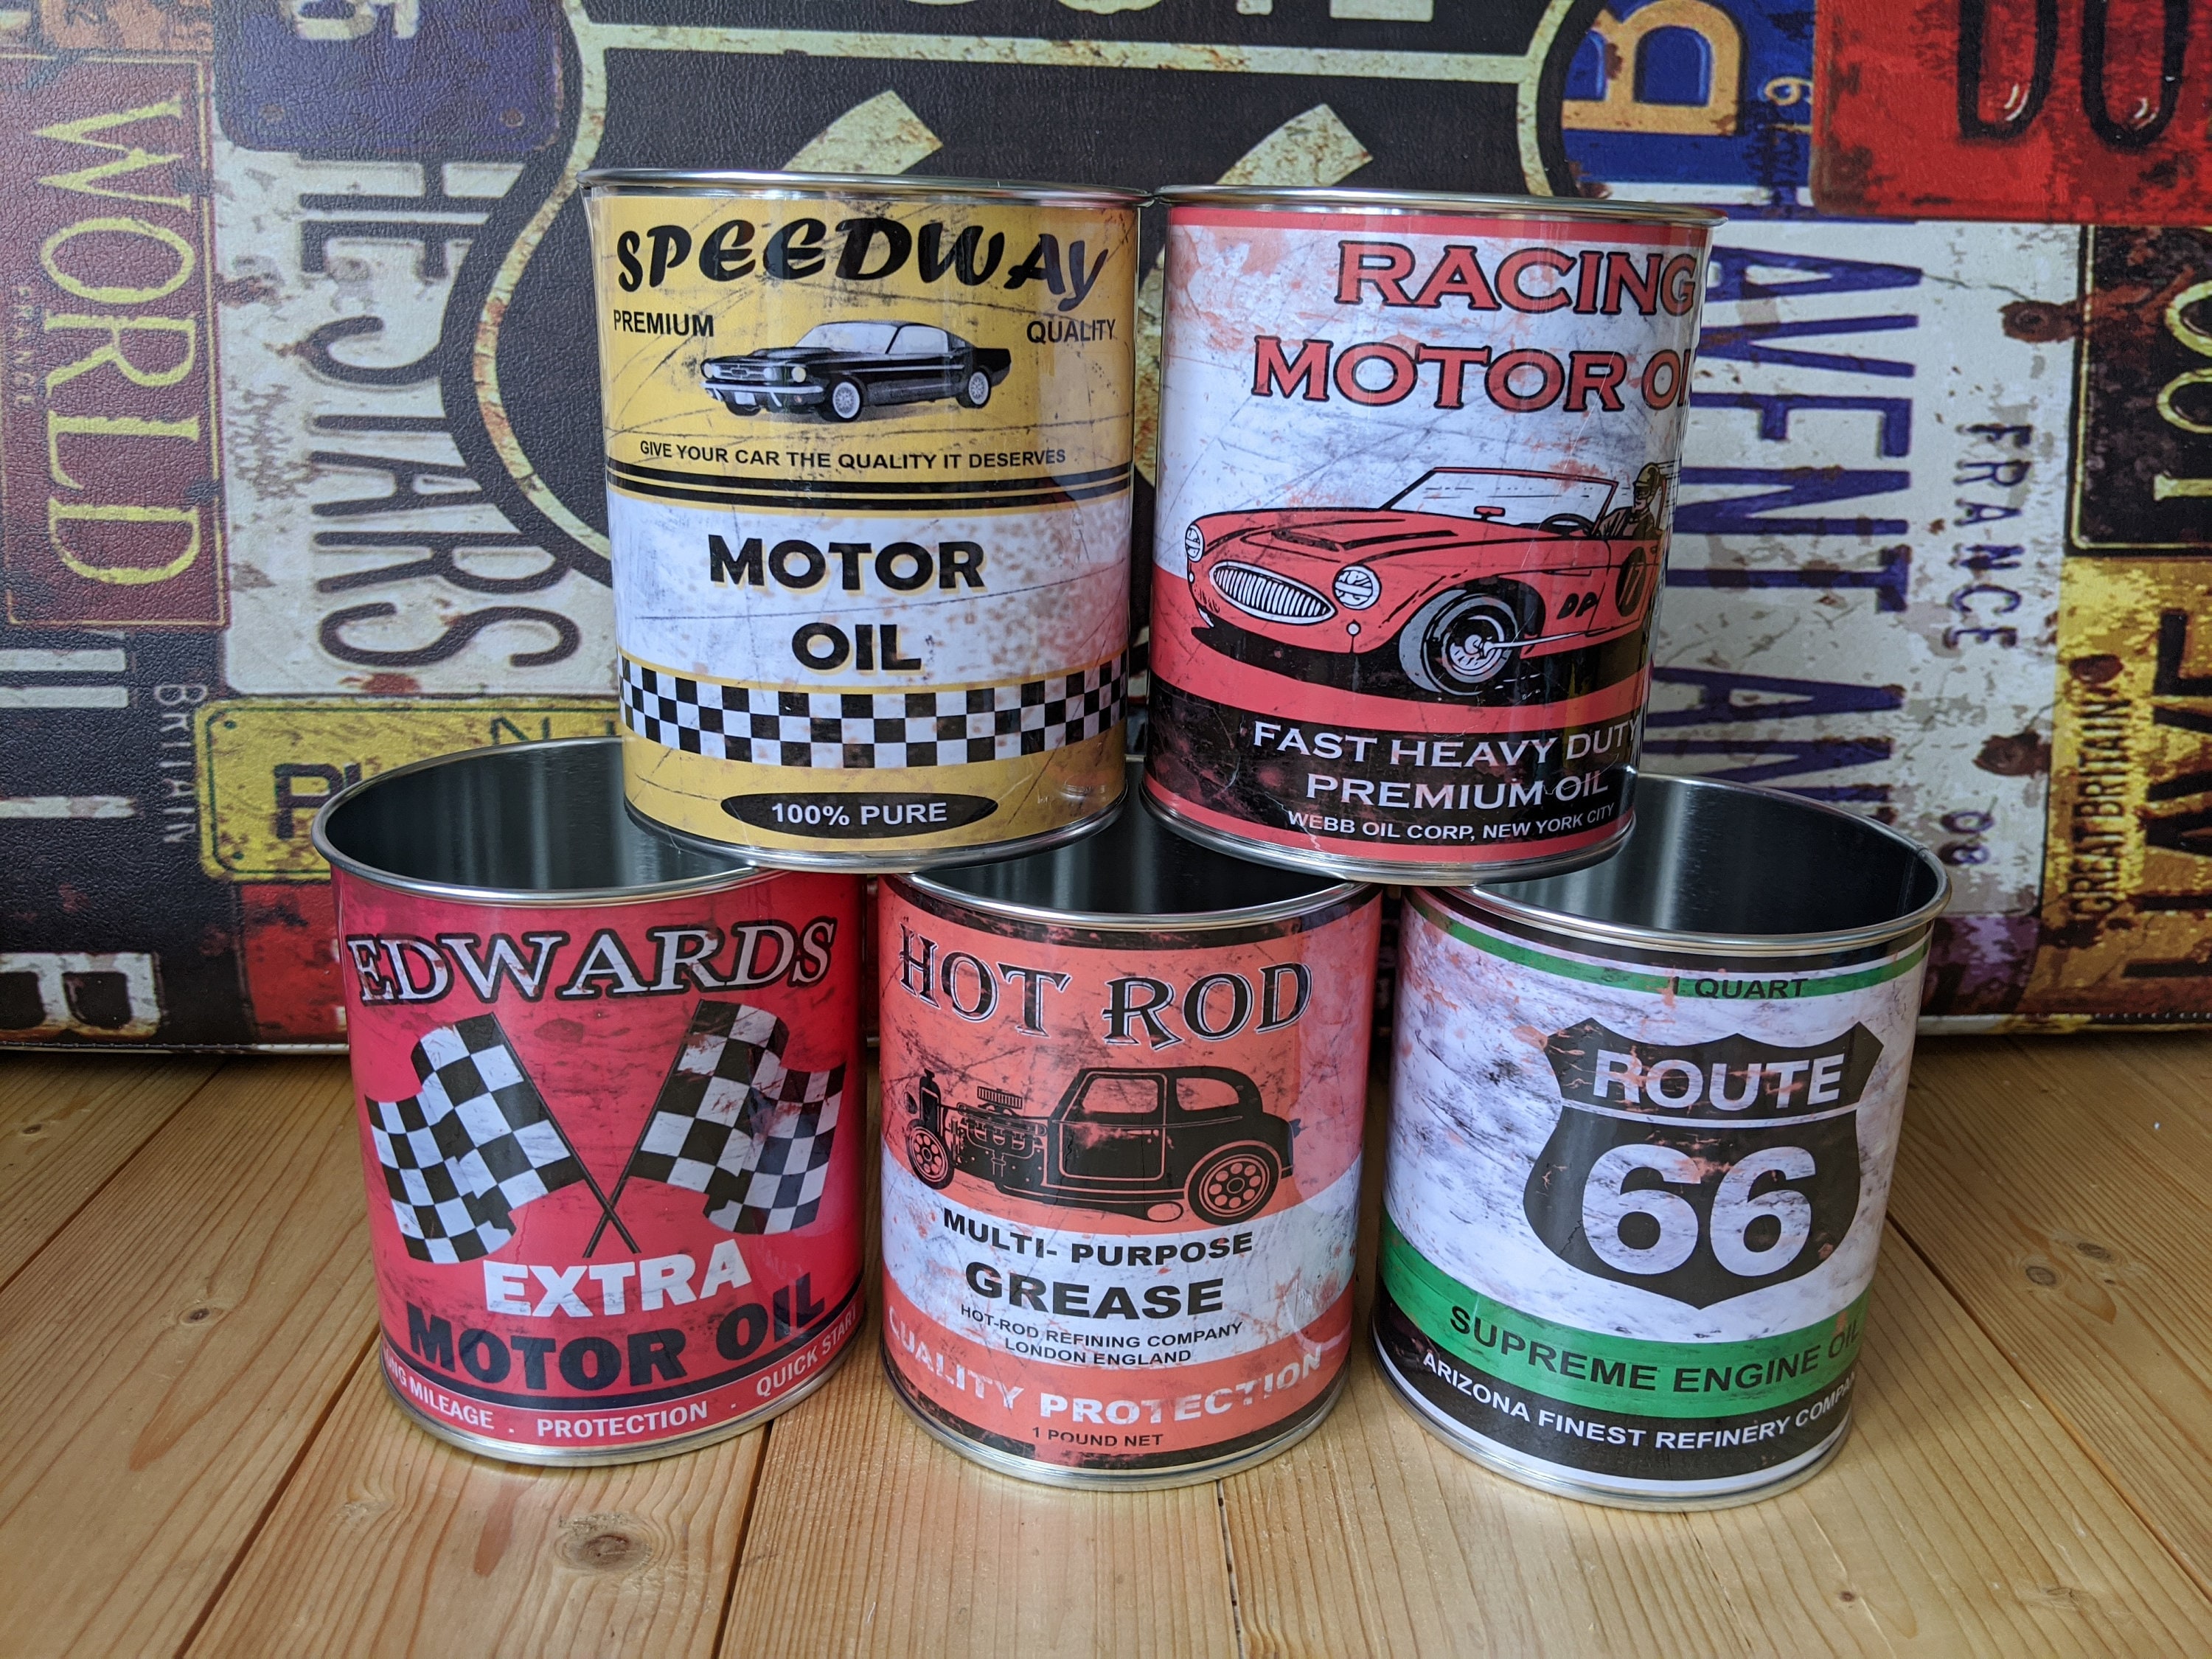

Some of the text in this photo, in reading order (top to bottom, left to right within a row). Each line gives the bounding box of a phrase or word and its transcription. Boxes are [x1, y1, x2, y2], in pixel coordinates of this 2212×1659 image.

[1334, 240, 1698, 315] RACING
[31, 92, 201, 585] WORLD
[613, 309, 1116, 344] PREMIUM QUALITY
[1251, 335, 1626, 413] MOTOR
[639, 440, 1066, 471] GIVE YOUR CAR THE QUALITY IT DESERVES
[708, 534, 986, 591] MOTOR
[1943, 422, 2033, 650] FRANCE
[791, 622, 922, 672] OIL
[153, 683, 209, 844] BRITAIN
[1254, 714, 1640, 769] FAST HEAVY DUTY
[1642, 666, 1907, 825] AN
[771, 801, 948, 826] 100% PURE
[1287, 810, 1356, 835] WEBB
[1361, 821, 1401, 839] OIL
[1483, 821, 1531, 839] NEW
[1535, 813, 1585, 835] YORK
[1587, 802, 1615, 824] CITY
[1307, 769, 1609, 810] PREMIUM OIL
[2070, 698, 2130, 917] GREAT BRITAIN
[345, 916, 838, 1006] EDWARDS
[897, 922, 1314, 1051] HOT ROD
[1695, 977, 1809, 1000] QUART
[1592, 1048, 1846, 1110] ROUTE
[1582, 1144, 1817, 1277] 66
[483, 1238, 752, 1317] EXTRA
[1071, 1231, 1253, 1267] PURPOSE
[961, 1304, 1243, 1349] HOT-ROD REFINING COMPANY
[965, 1261, 1225, 1320] GREASE
[406, 1272, 825, 1391] MOTOR OIL
[1005, 1337, 1192, 1366] LONDON ENGLAND
[1450, 1304, 1860, 1393] SUPREME ENGINE OIL
[409, 1376, 495, 1430] MILEAGE
[537, 1400, 708, 1439] PROTECTION
[756, 1346, 818, 1398] QUICK
[822, 1304, 857, 1355] START
[1040, 1343, 1324, 1425] PROTECTION
[1422, 1352, 1531, 1422] ARIZONA
[1538, 1408, 1648, 1447] FINEST
[1655, 1416, 1792, 1450] REFINERY
[1032, 1427, 1164, 1447] 1 POUND NET
